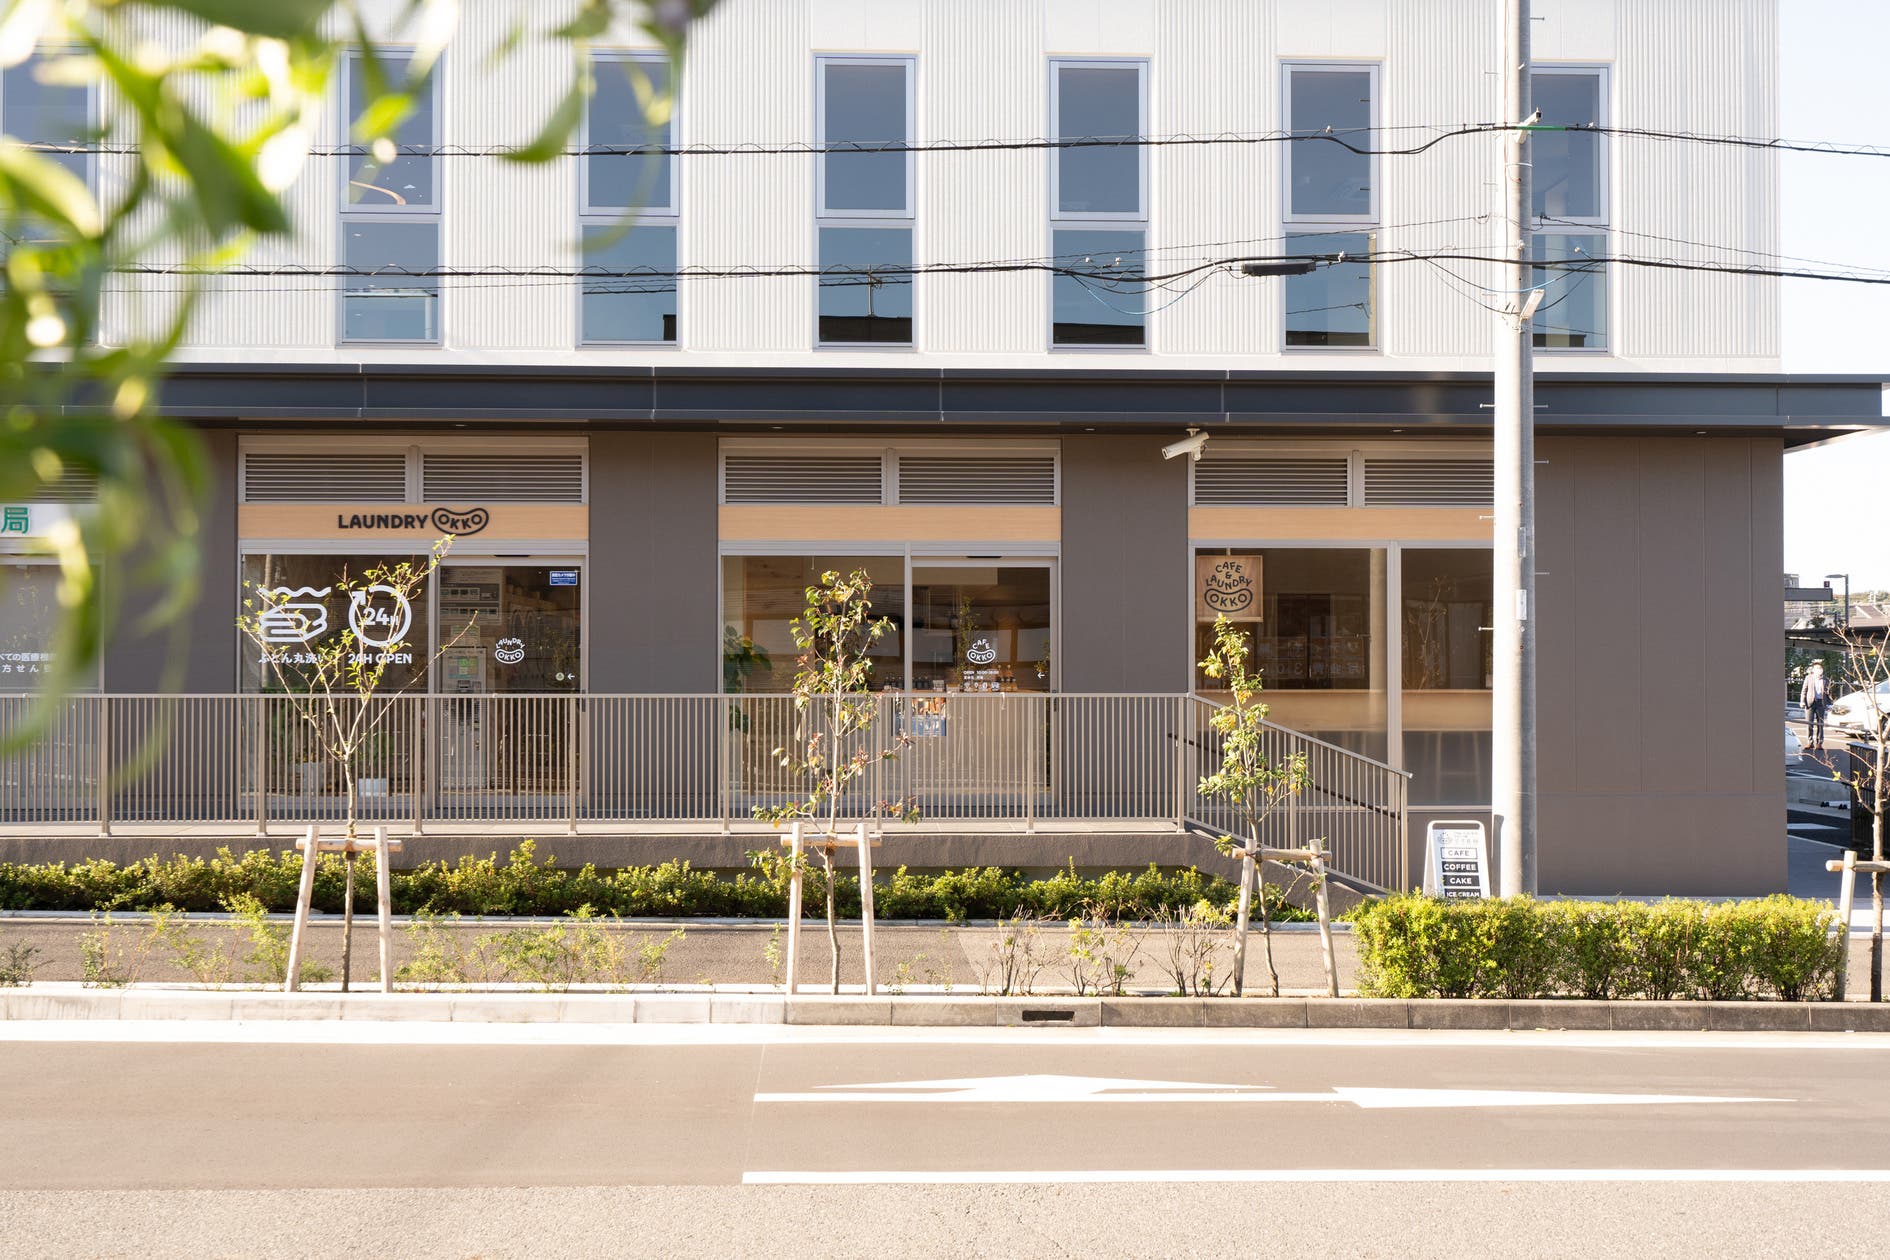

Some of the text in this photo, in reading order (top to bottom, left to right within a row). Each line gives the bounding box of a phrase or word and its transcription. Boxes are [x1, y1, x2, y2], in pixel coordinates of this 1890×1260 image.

[1, 507, 30, 534] 局
[338, 513, 483, 530] LAUNDRY OKKO
[1215, 561, 1242, 573] CAFE
[1225, 571, 1232, 579] &
[1206, 575, 1252, 590] LAUNDRY
[1210, 593, 1247, 607] OKKO
[496, 637, 525, 649] LAUNDRY
[972, 639, 990, 650] CAFE
[375, 653, 412, 664] OPEN
[498, 652, 521, 661] OKKO
[970, 652, 993, 661] OKKO
[1443, 863, 1476, 871] COFFEE
